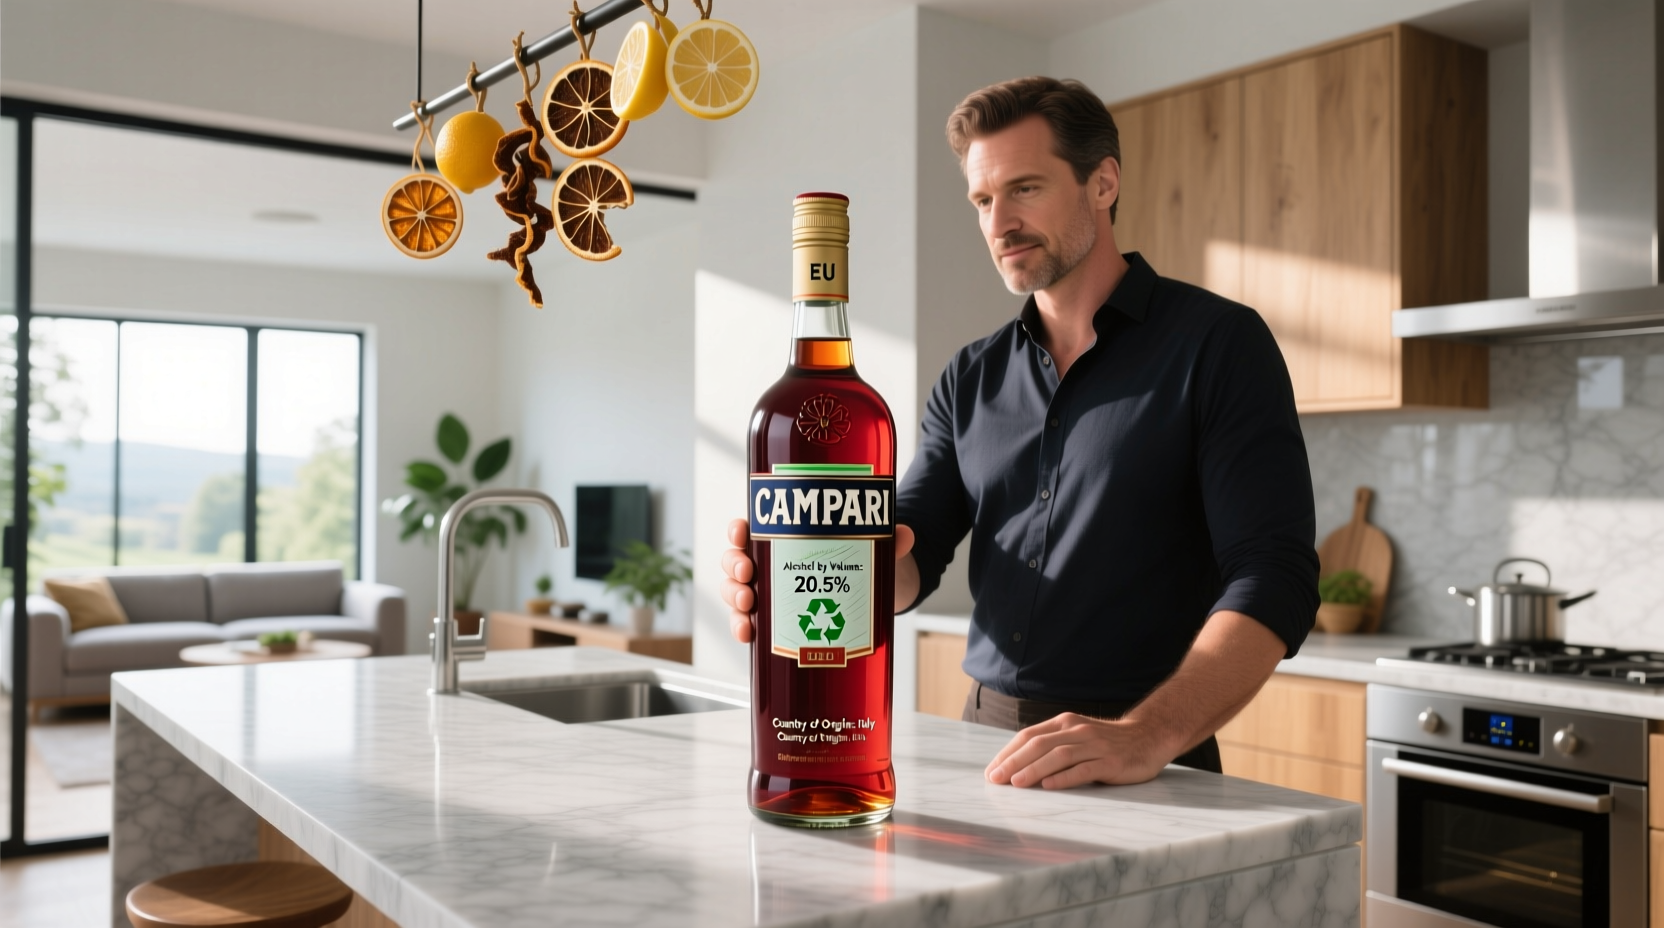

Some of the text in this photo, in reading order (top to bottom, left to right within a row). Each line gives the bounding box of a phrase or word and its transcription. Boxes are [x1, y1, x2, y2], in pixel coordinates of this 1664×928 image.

[810, 263, 835, 281] EU
[755, 487, 889, 526] CAMPARI
[794, 576, 851, 593] 20.5%
